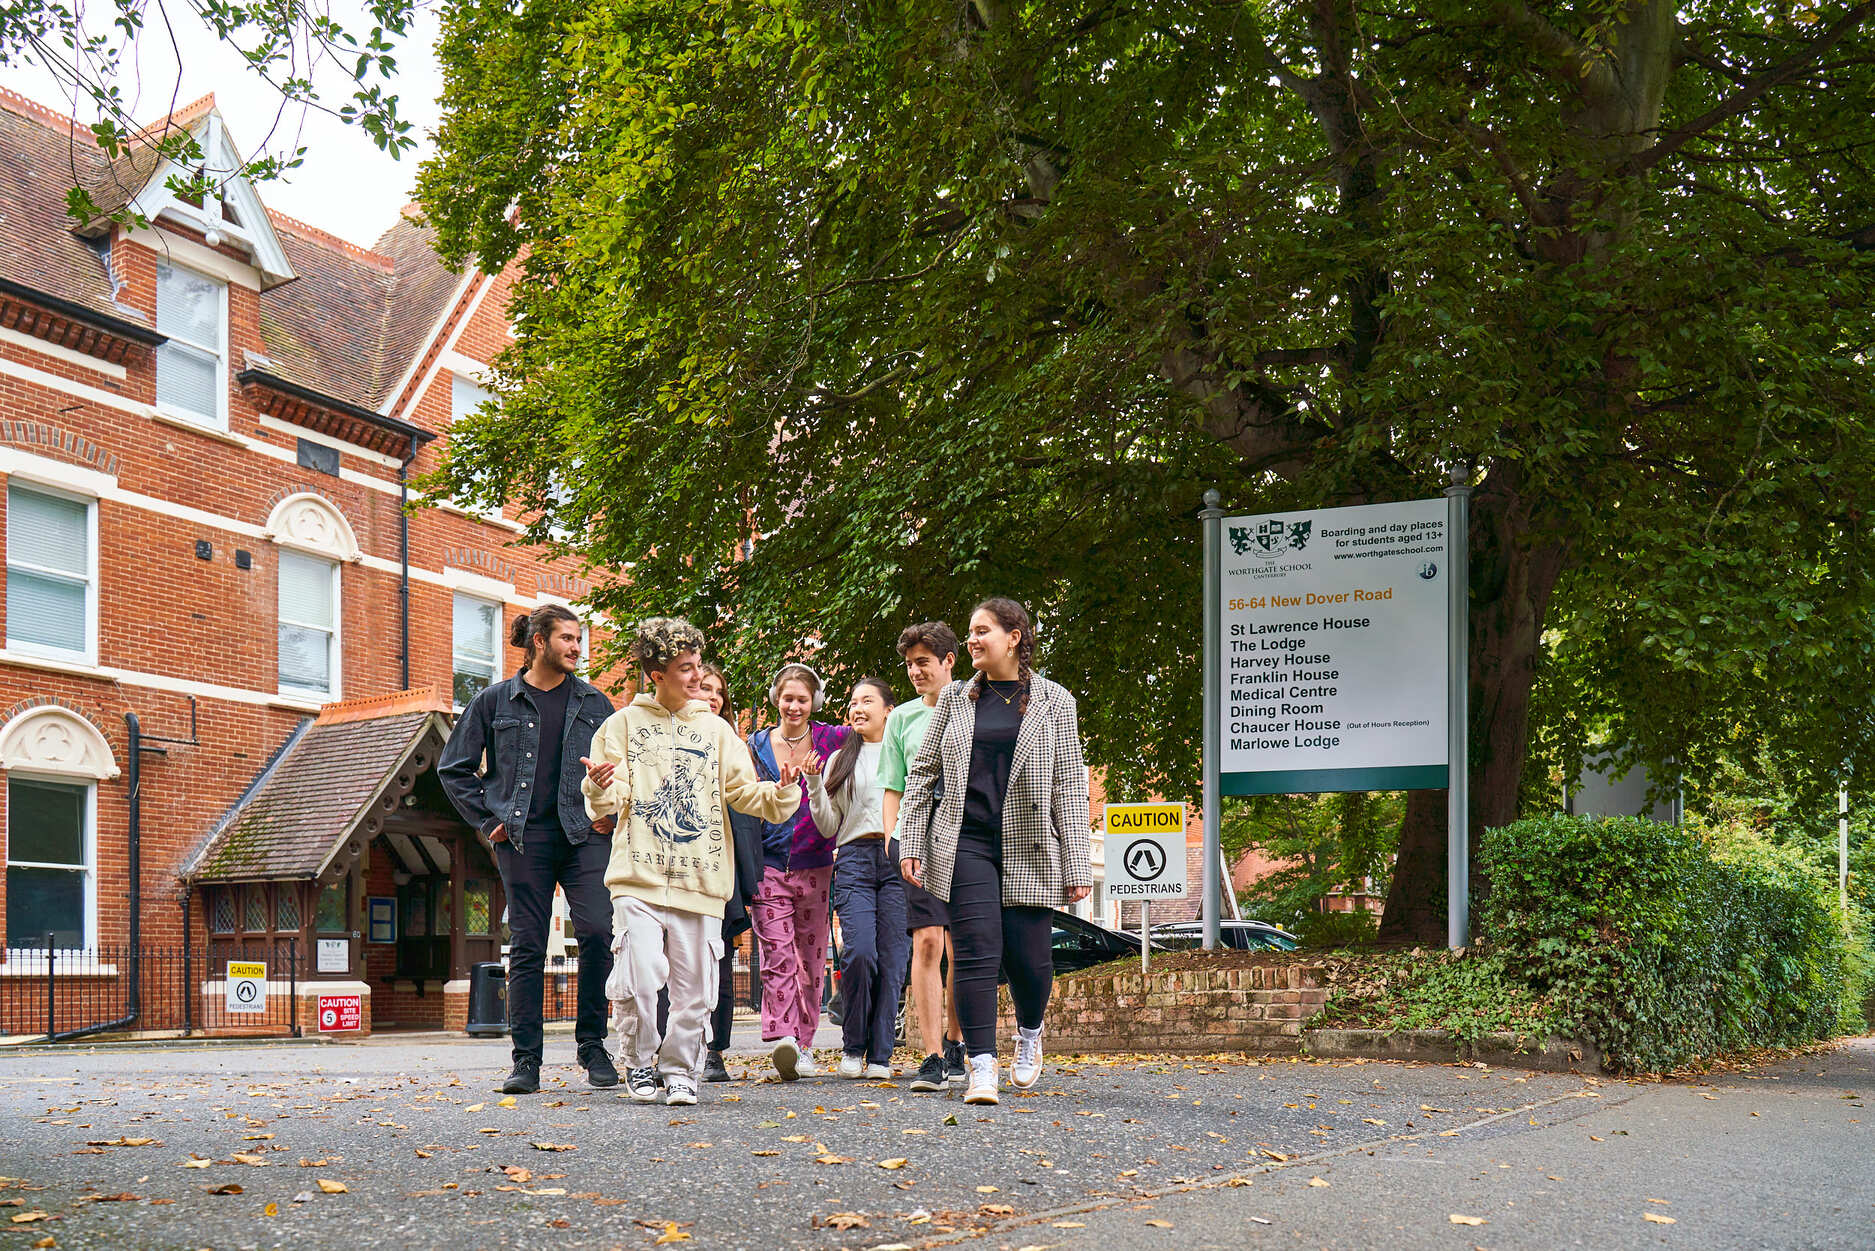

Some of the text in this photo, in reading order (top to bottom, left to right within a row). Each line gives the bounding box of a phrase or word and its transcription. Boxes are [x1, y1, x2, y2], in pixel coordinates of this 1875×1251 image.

[1321, 520, 1444, 538] Boarding and day places
[1335, 531, 1443, 547] for students aged 13+
[1334, 545, 1444, 560] www.worthgateschool.com
[1228, 563, 1313, 576] WORTHGATE SCHOOL
[1228, 587, 1393, 610] 56-64 New Dover Road
[1230, 617, 1370, 636] St Lawrence House
[1230, 638, 1306, 652] The Lodge
[1230, 653, 1331, 669] Harvey House
[1230, 669, 1339, 685] Franklin House
[1230, 686, 1337, 701] Medical Centre
[1230, 703, 1323, 719] Dining Room
[1230, 722, 1290, 734] Chaucer
[1294, 719, 1341, 731] House
[1346, 722, 1361, 730] (Out
[1393, 719, 1430, 728] Reception)
[1230, 735, 1340, 750] Marlowe Lodge
[1111, 811, 1180, 827] CAUTION
[1110, 883, 1182, 895] PEDESTRIANS
[231, 966, 264, 975] CAUTION
[320, 998, 359, 1008] CAUTION
[327, 1013, 332, 1023] 5
